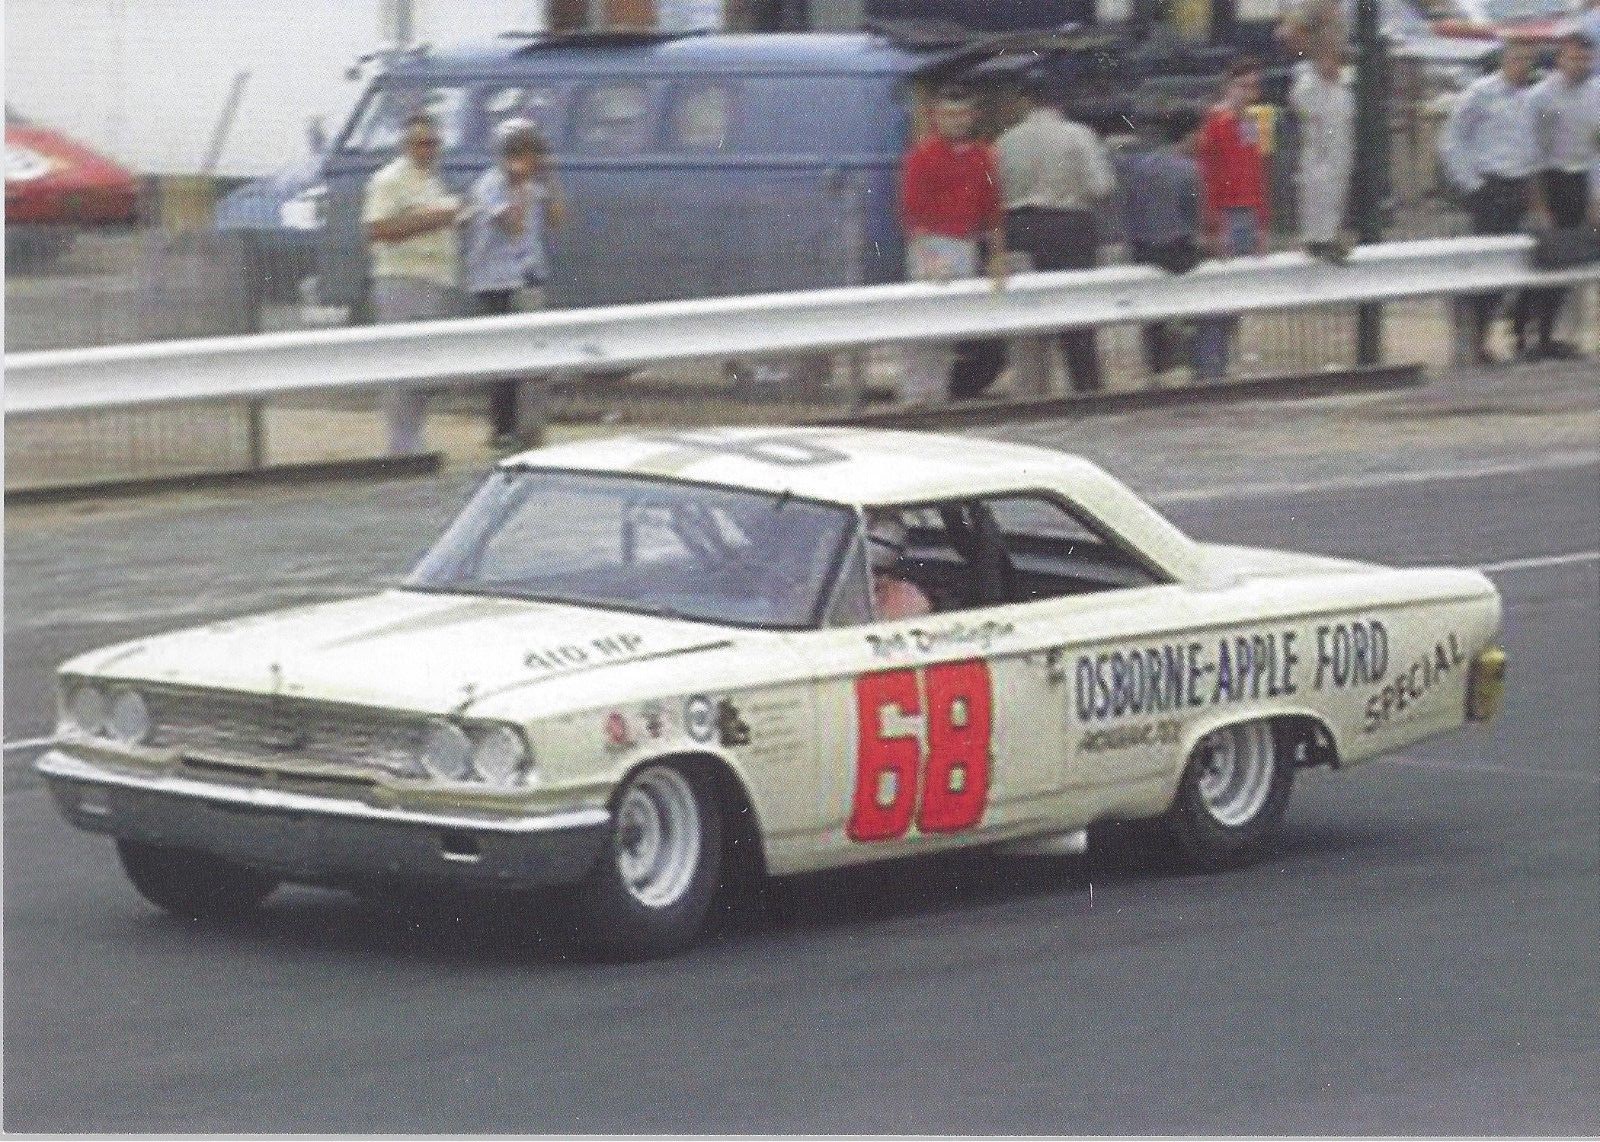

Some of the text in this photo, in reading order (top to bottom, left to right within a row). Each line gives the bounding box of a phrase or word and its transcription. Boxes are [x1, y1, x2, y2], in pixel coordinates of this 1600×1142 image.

[1075, 620, 1390, 721] OSBORNE-APPLE FORD
[1363, 631, 1465, 735] SPECIAL
[844, 656, 994, 843] 68
